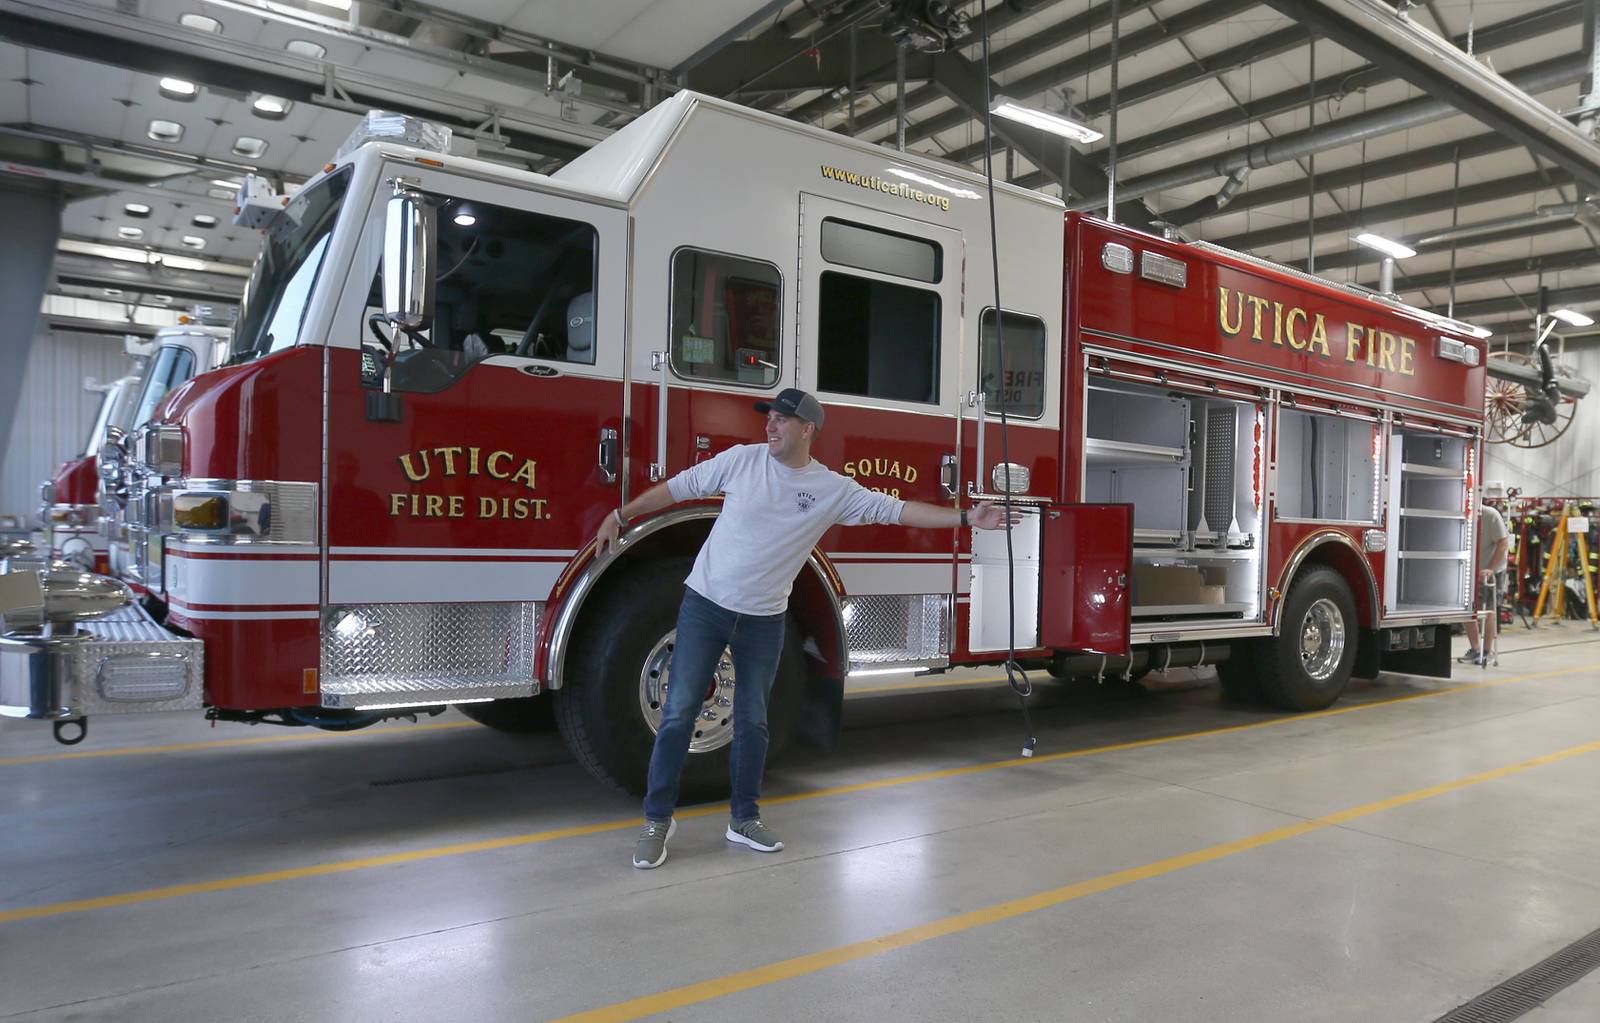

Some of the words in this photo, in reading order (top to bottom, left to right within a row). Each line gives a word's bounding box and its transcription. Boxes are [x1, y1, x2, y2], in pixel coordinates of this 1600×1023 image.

[821, 165, 950, 211] www.uticafire.org
[1219, 287, 1331, 357] UTICA
[1345, 322, 1415, 376] FIRE
[399, 447, 537, 489] UTICA
[843, 458, 918, 484] SQUAD
[389, 493, 465, 517] FIRE
[479, 497, 551, 520] DIST.
